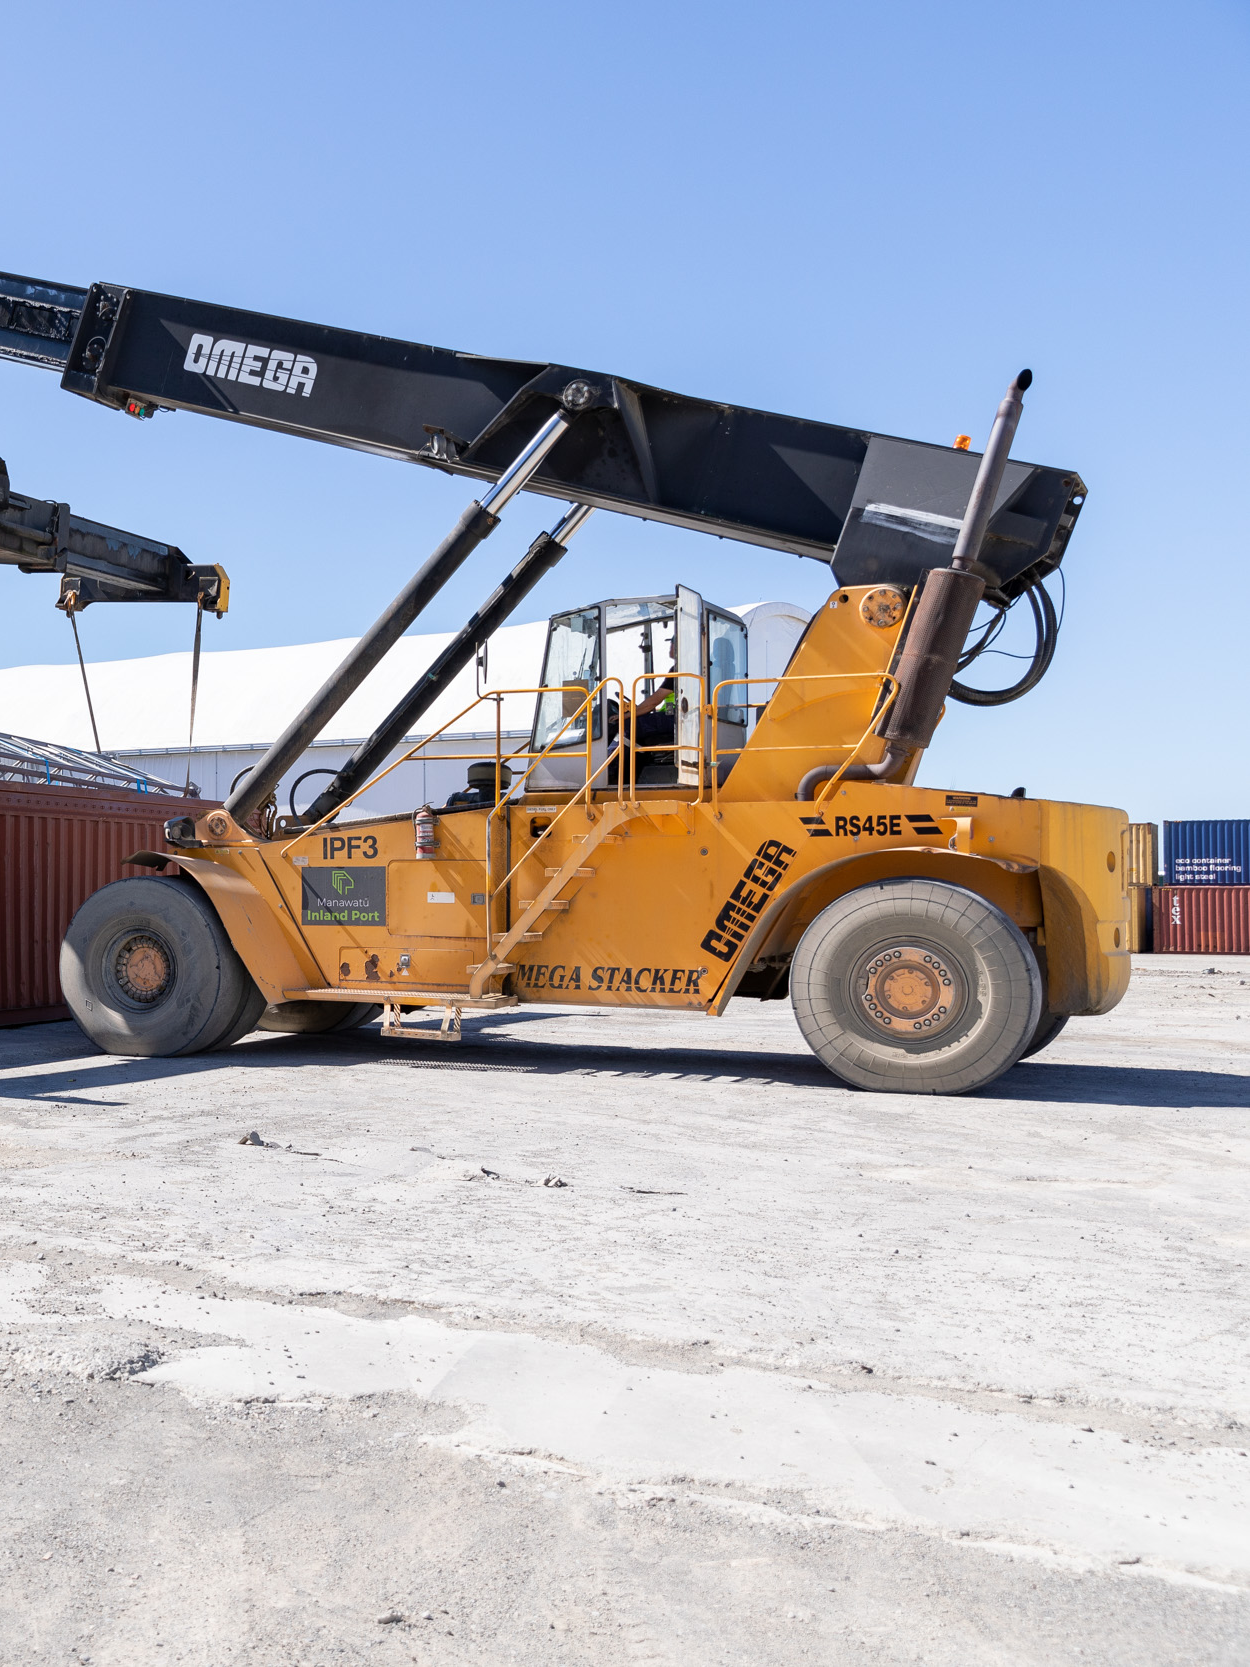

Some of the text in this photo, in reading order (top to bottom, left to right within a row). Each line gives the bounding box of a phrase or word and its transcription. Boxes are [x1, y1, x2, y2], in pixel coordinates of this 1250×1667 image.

[183, 333, 318, 398] OMEGA
[834, 815, 902, 836] RS45E
[322, 835, 378, 860] IPF3
[1210, 864, 1241, 872] flooring
[317, 898, 370, 907] Manawatū
[700, 839, 797, 962] OMEGA
[1171, 895, 1181, 924] tex
[308, 910, 379, 921] Inland Port
[516, 964, 701, 994] MEGA STACKER
